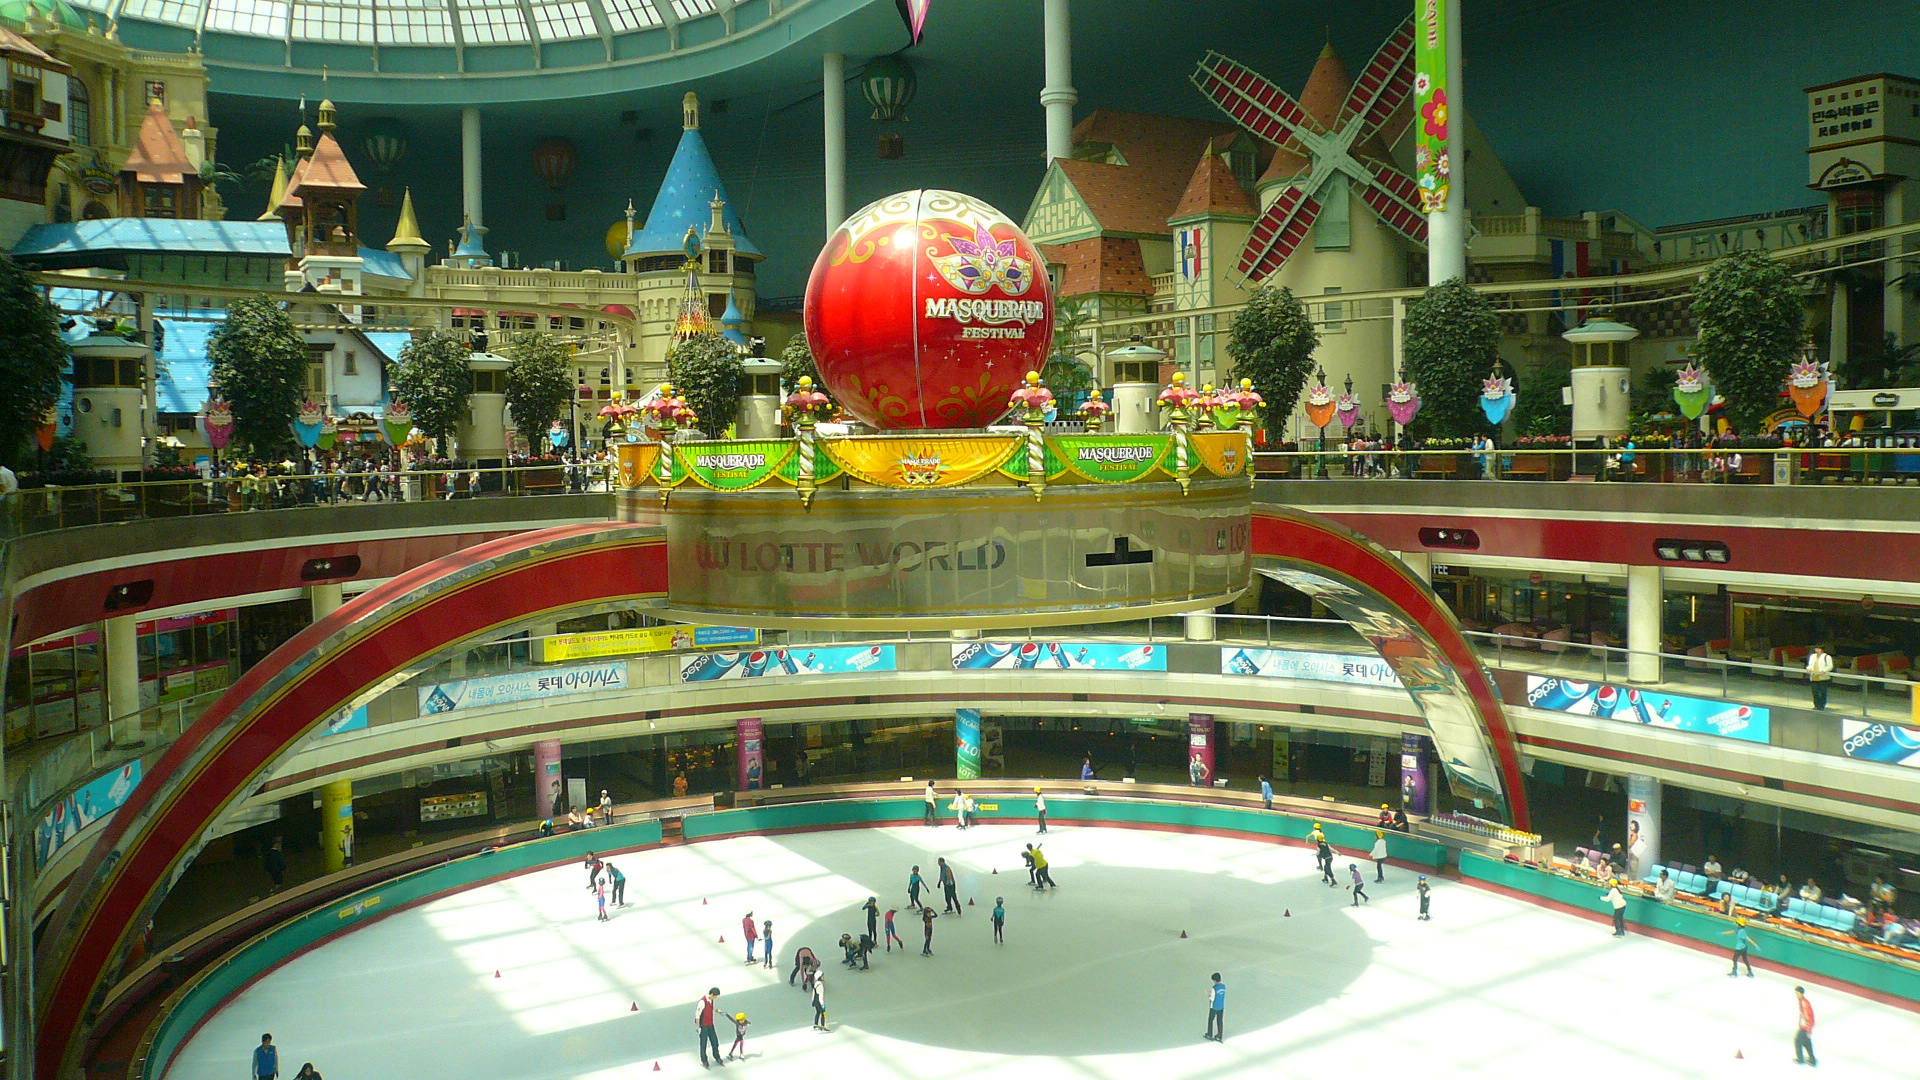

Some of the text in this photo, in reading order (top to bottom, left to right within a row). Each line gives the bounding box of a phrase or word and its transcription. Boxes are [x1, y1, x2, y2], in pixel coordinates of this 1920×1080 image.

[926, 298, 1045, 325] MASQUERADE
[962, 327, 1026, 339] FESTIVAL
[696, 453, 765, 470] MASQUERADE
[1078, 446, 1153, 463] MASQUERADE
[1099, 463, 1138, 472] FESTIVAL
[712, 471, 749, 479] FESTIVAL
[740, 538, 1006, 572] LOTTE WORLD
[681, 655, 710, 683] pepsi
[952, 643, 982, 669] pepsi
[1301, 660, 1336, 673] 오아시스
[1342, 663, 1368, 677] 롯데
[468, 668, 620, 700] 내몸에 오아시스 롯데 아이시스
[1527, 678, 1558, 707] pepsi
[1843, 723, 1887, 756] pepsi
